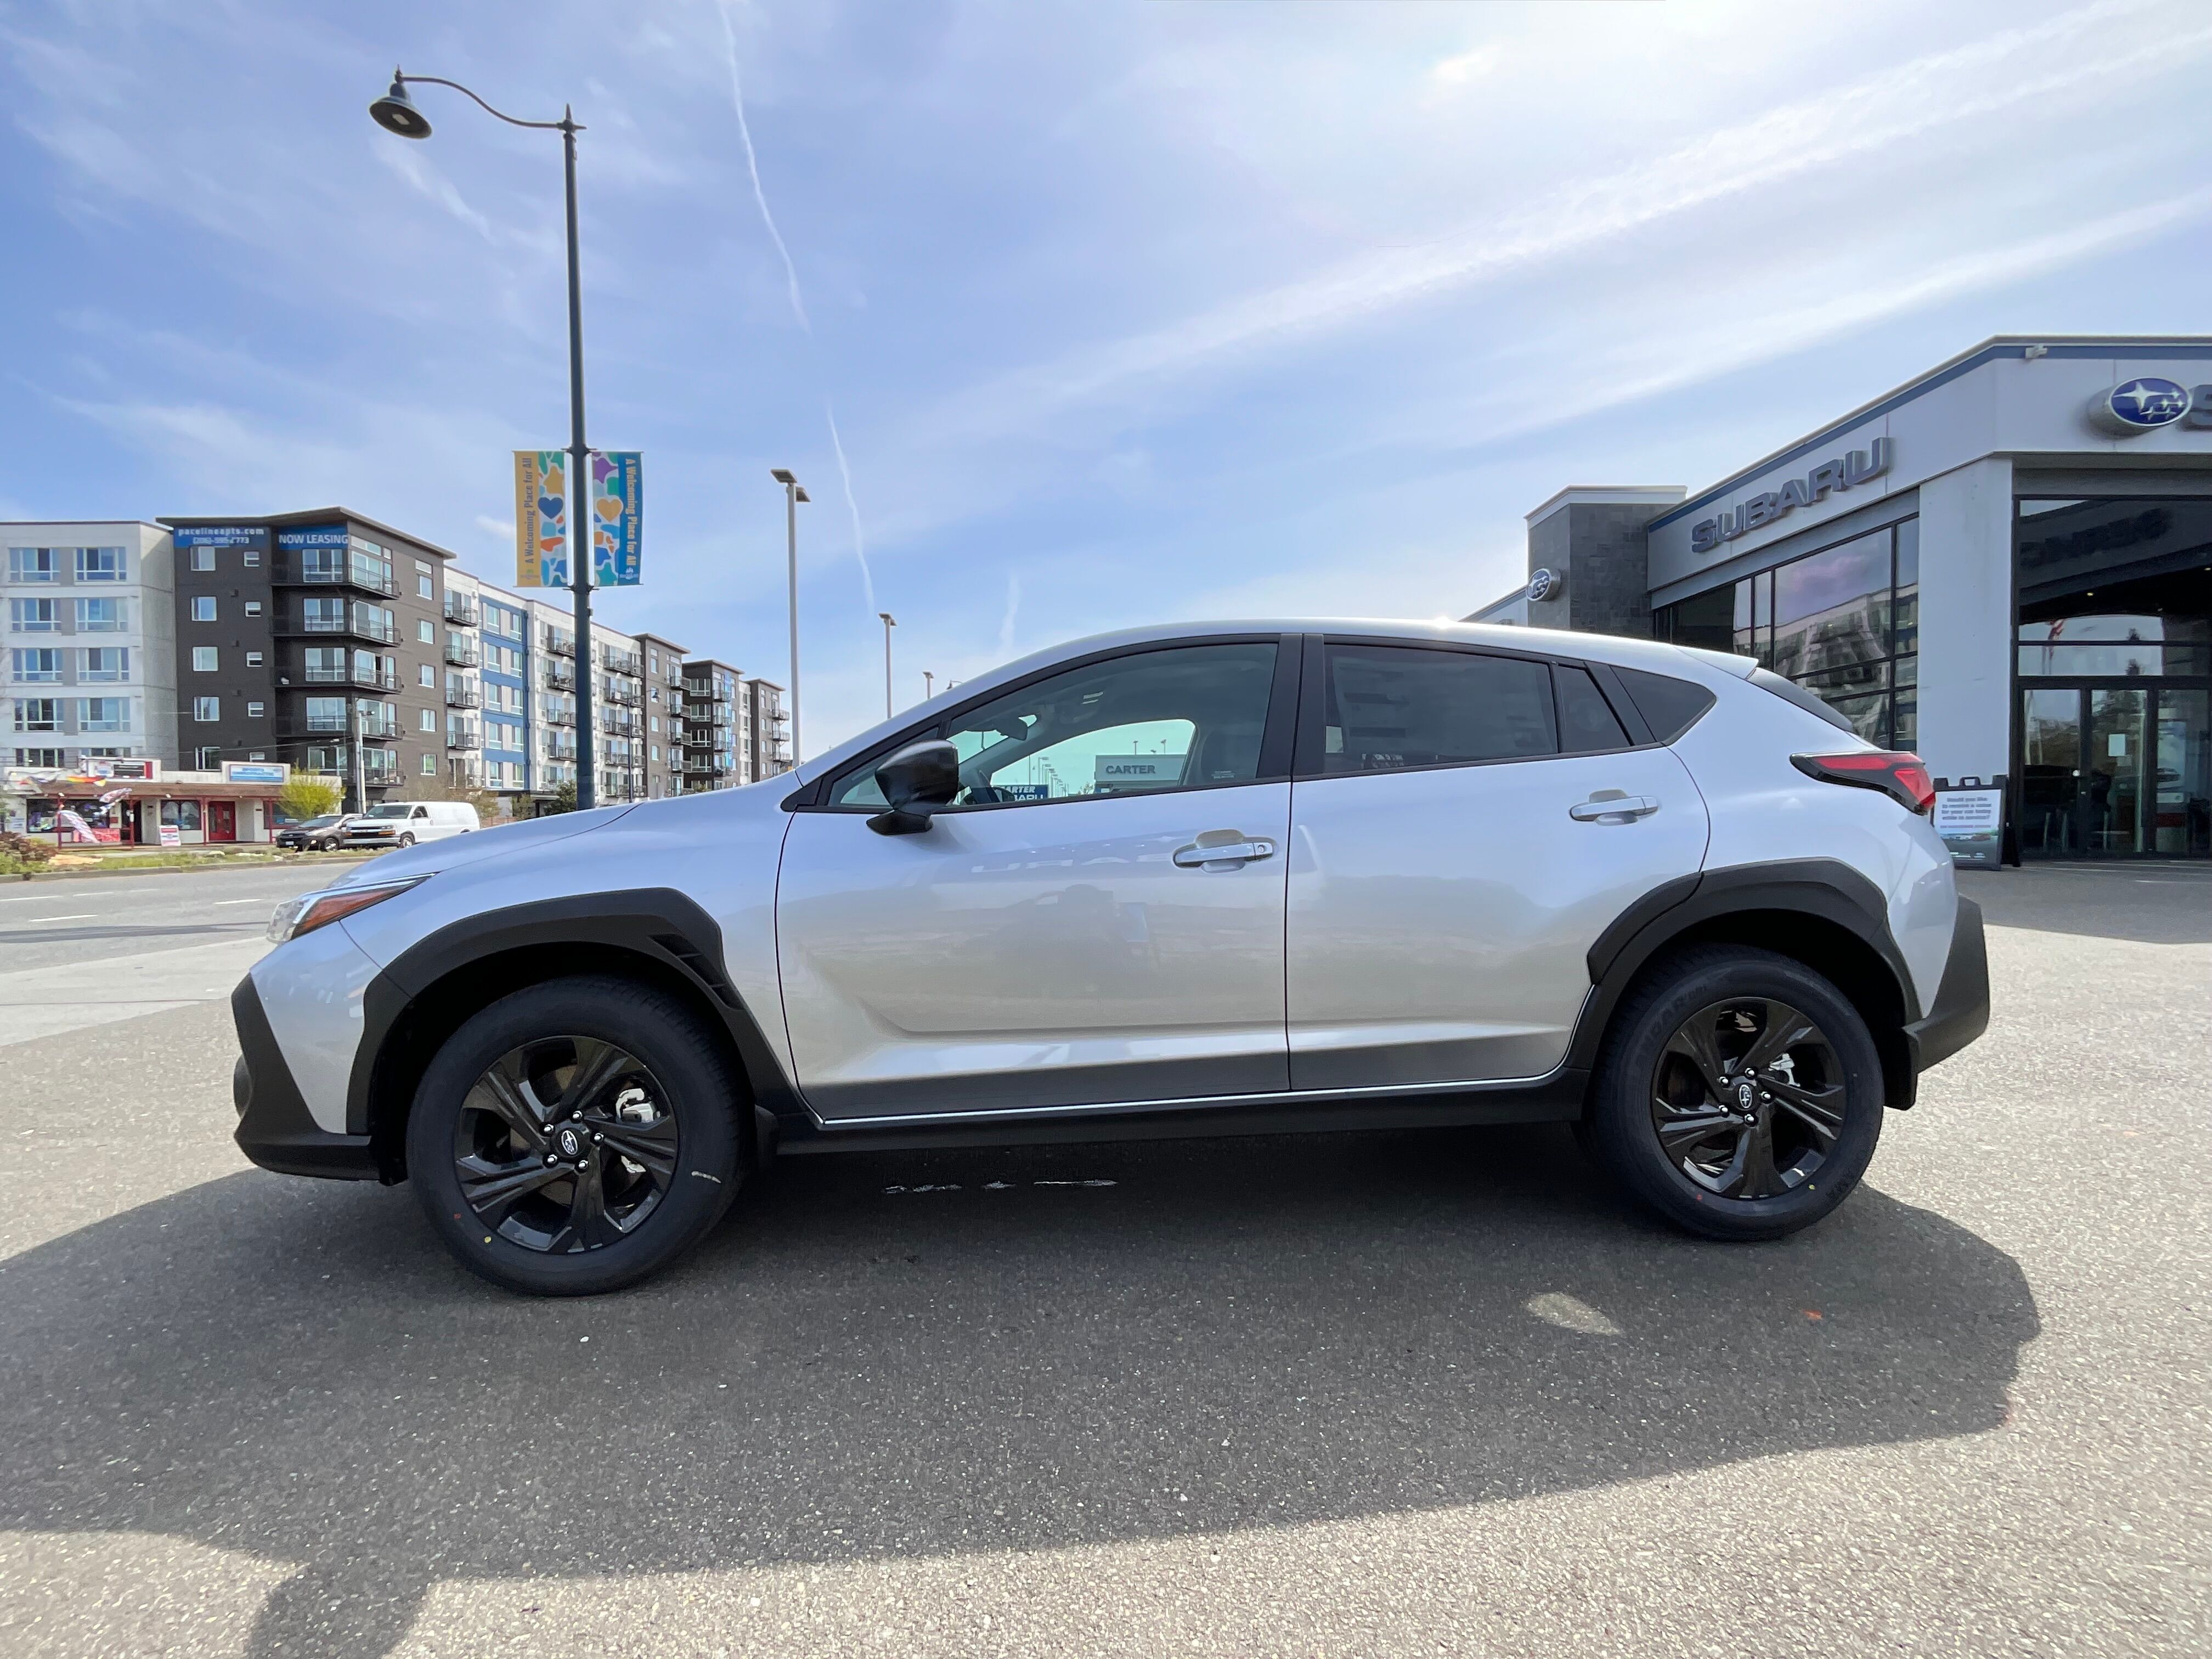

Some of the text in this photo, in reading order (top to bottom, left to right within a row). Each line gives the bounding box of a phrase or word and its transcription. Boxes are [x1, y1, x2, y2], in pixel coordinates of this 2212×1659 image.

[522, 458, 532, 468] All
[523, 471, 533, 483] for
[524, 485, 533, 507] Place
[625, 466, 637, 515] Welcoming
[1691, 437, 1890, 553] SUBARU
[524, 510, 535, 556] Welcoming
[628, 516, 637, 539] Place
[279, 534, 348, 544] NOW LEASING
[627, 541, 637, 553] for
[627, 556, 636, 566] All
[1105, 765, 1156, 774] CARTER
[1001, 785, 1036, 793] ARTER
